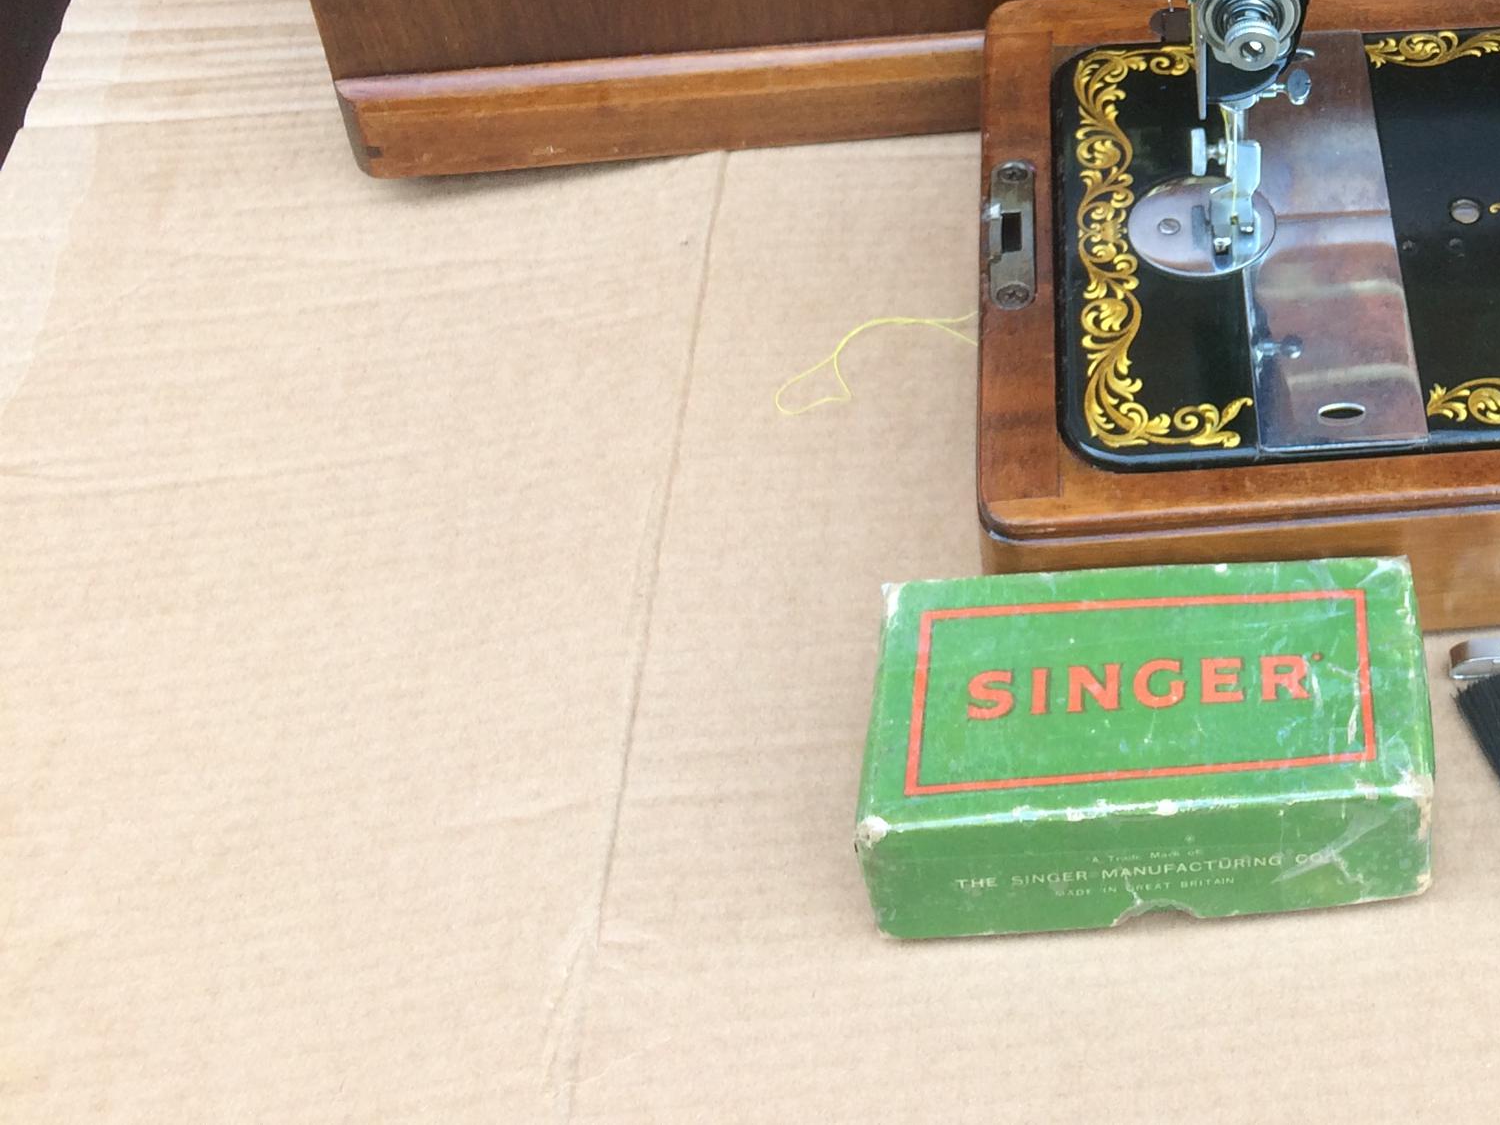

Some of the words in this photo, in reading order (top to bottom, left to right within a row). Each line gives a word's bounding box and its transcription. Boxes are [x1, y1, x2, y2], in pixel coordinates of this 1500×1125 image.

[967, 655, 1312, 722] SINGER
[955, 877, 998, 889] THE
[1011, 871, 1088, 886] SINGER
[1102, 854, 1282, 879] MANUFACTURING
[1180, 877, 1235, 889] BRITAIN
